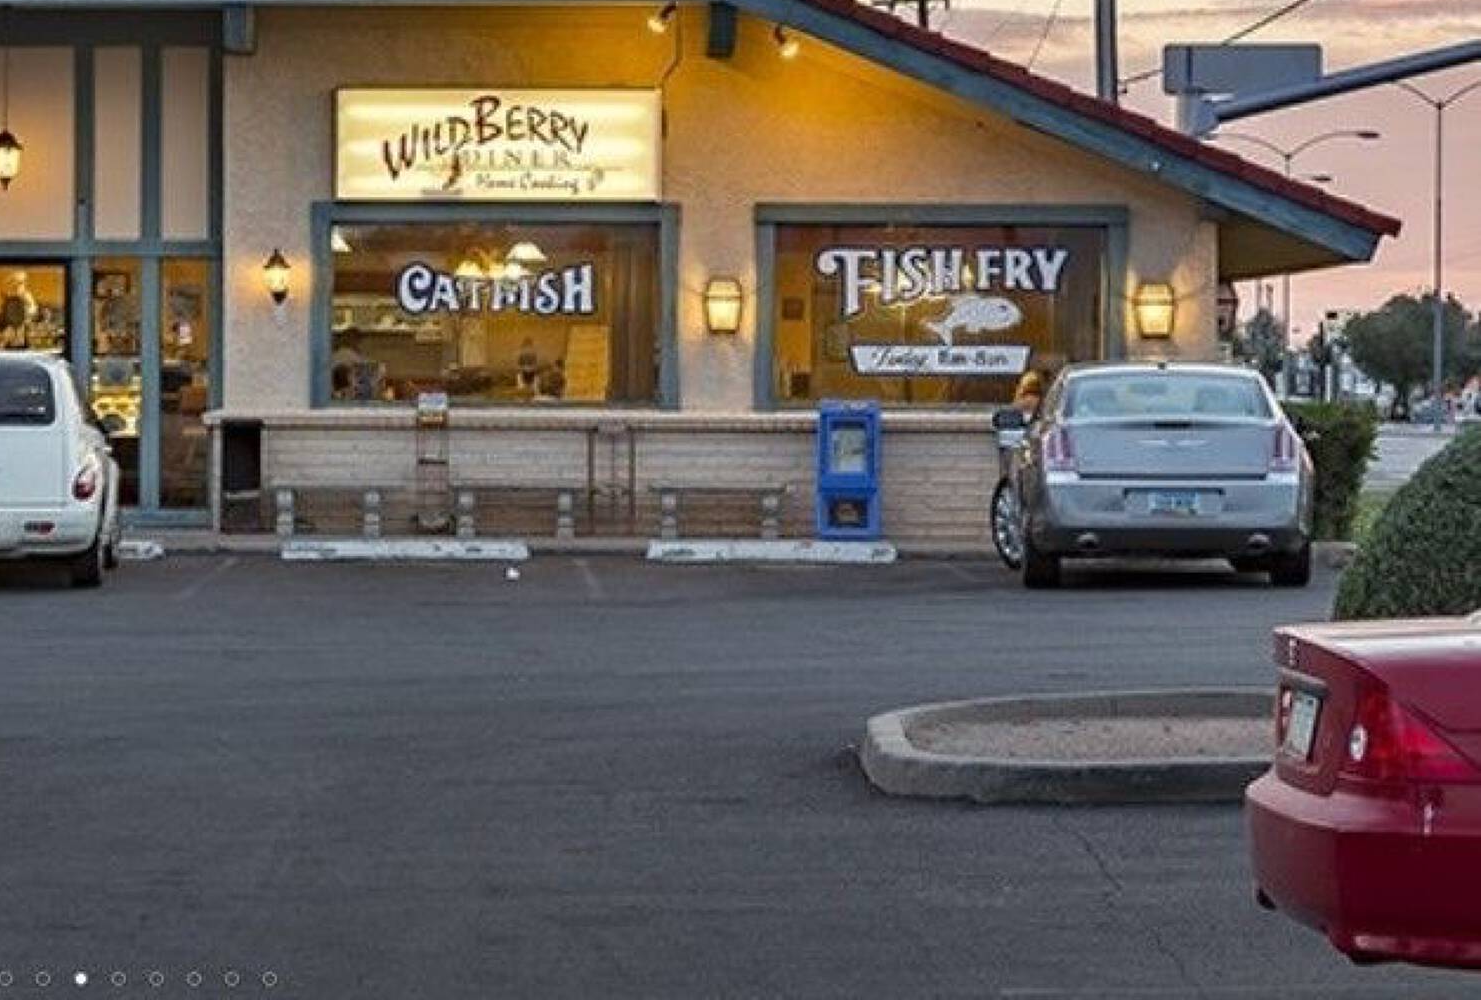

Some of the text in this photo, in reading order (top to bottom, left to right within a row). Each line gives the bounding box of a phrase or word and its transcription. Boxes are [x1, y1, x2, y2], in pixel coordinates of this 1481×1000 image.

[462, 149, 571, 169] DINER
[397, 261, 595, 314] CATFISH
[817, 247, 1069, 316] FISH FRY
